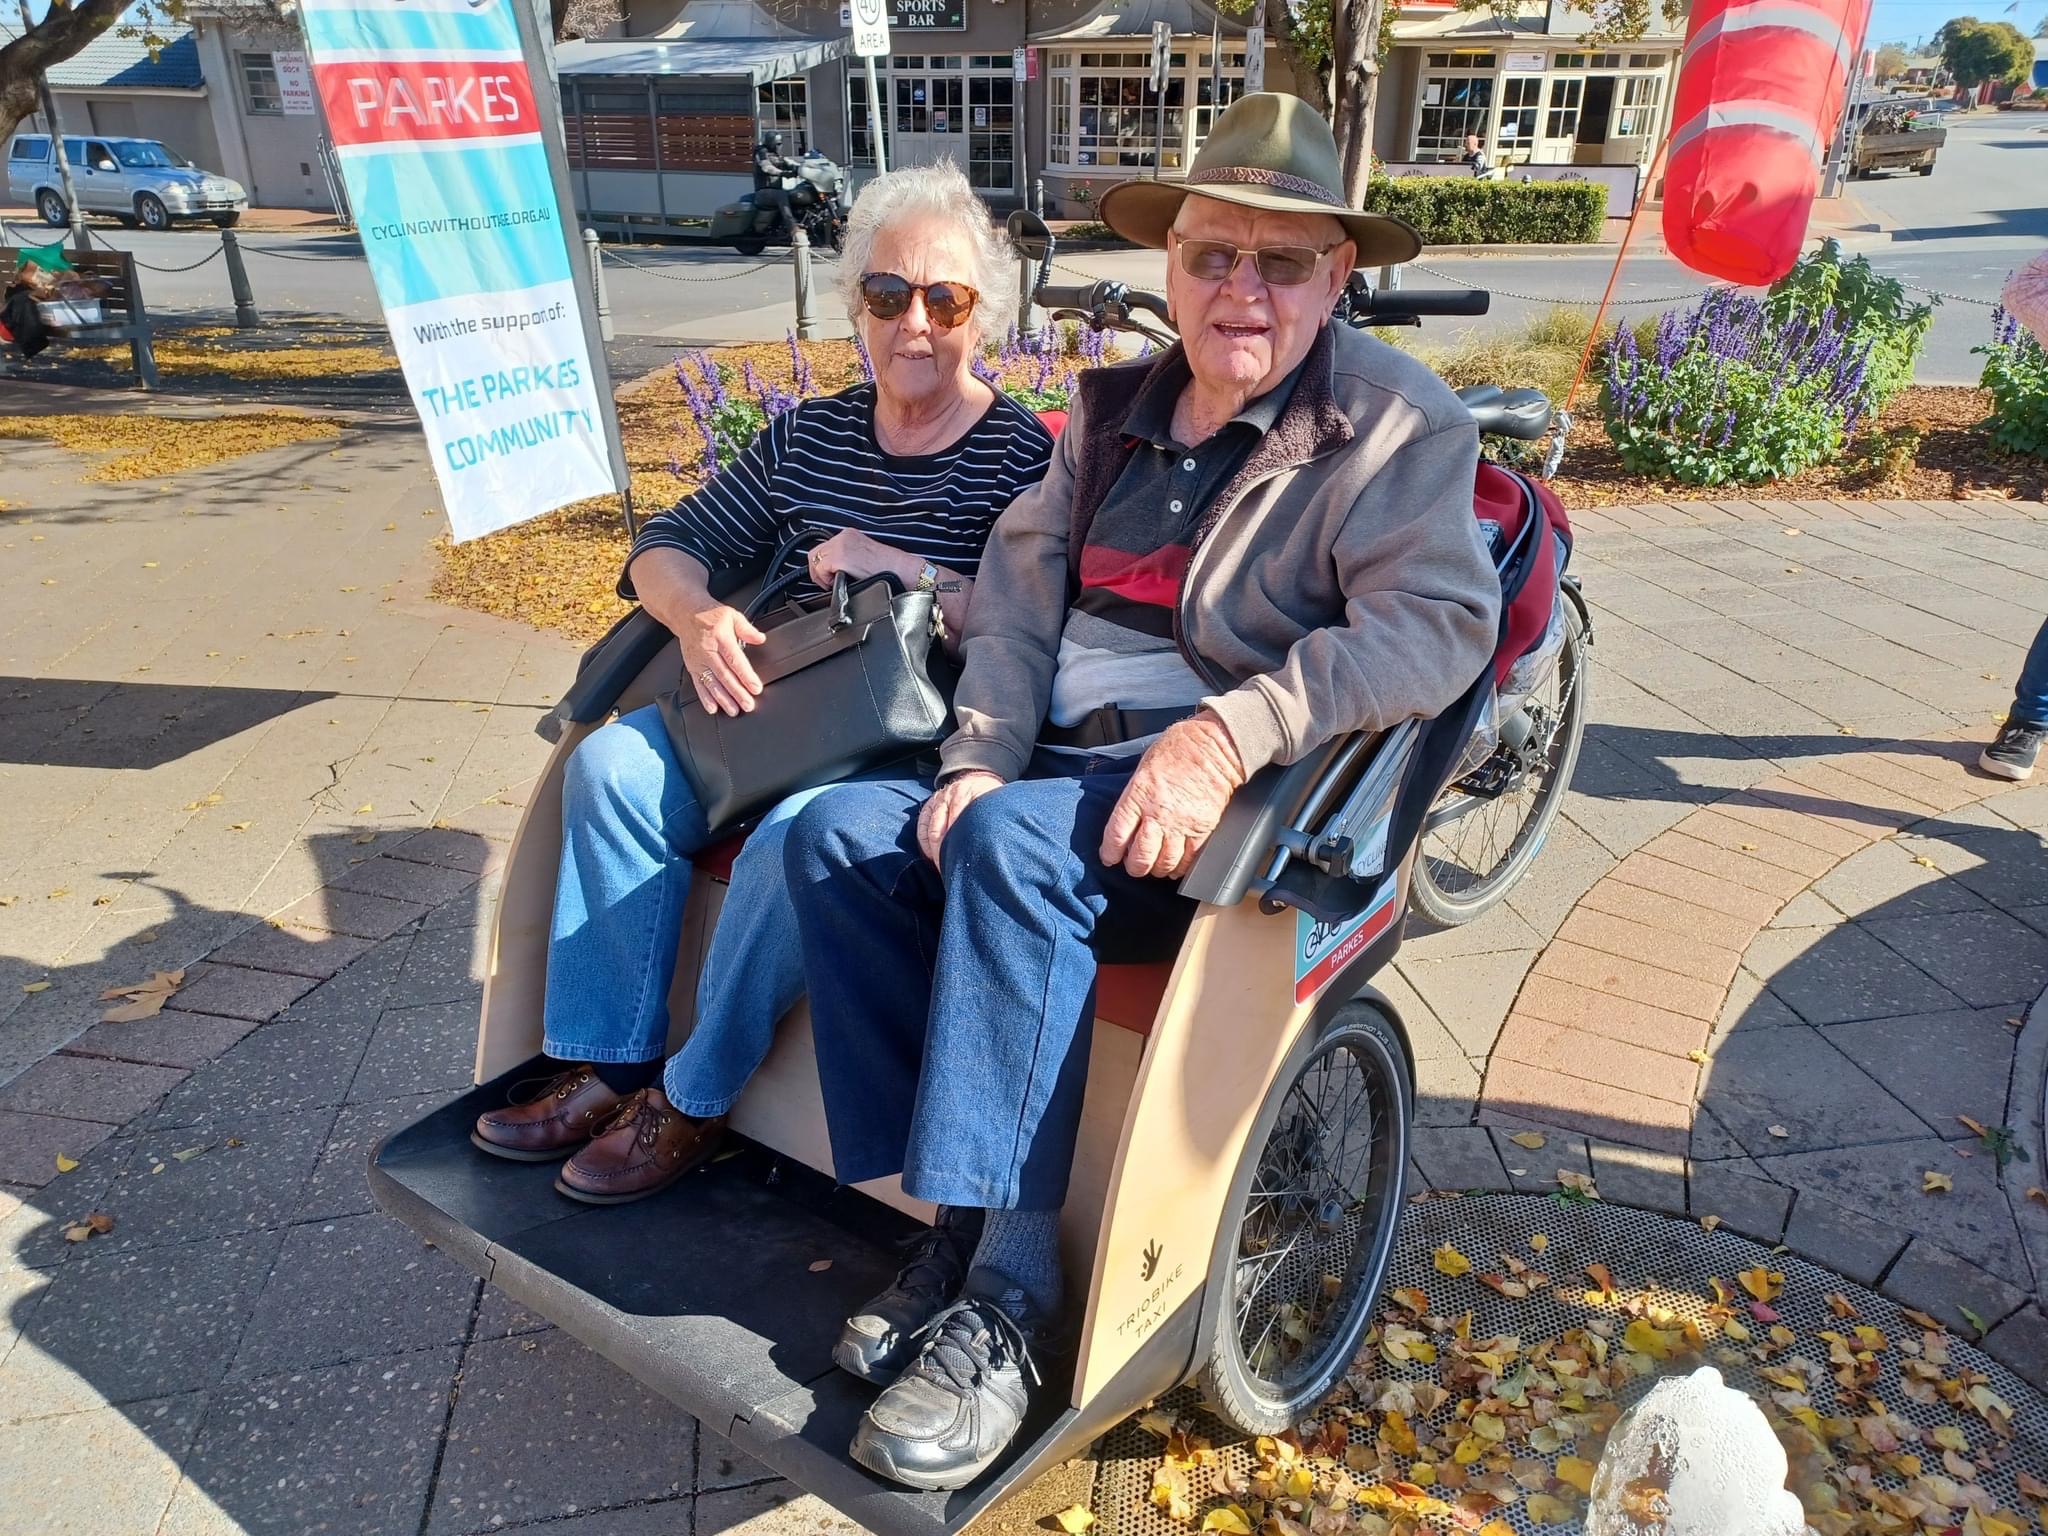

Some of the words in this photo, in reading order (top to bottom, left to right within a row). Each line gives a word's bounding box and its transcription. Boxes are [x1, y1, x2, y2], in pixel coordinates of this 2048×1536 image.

[896, 0, 946, 12] SPORTS
[908, 14, 936, 26] BAR
[860, 33, 885, 48] AREA
[347, 75, 520, 129] PARKES
[413, 320, 452, 345] With
[449, 317, 478, 337] the
[547, 301, 567, 321] of:
[422, 378, 481, 418] THE
[480, 358, 580, 403] PARKES
[444, 407, 593, 471] COMMUNITY
[1331, 929, 1364, 969] PARKES
[1116, 1263, 1184, 1337] TRIOBIKE
[1134, 1301, 1166, 1338] TAXI
